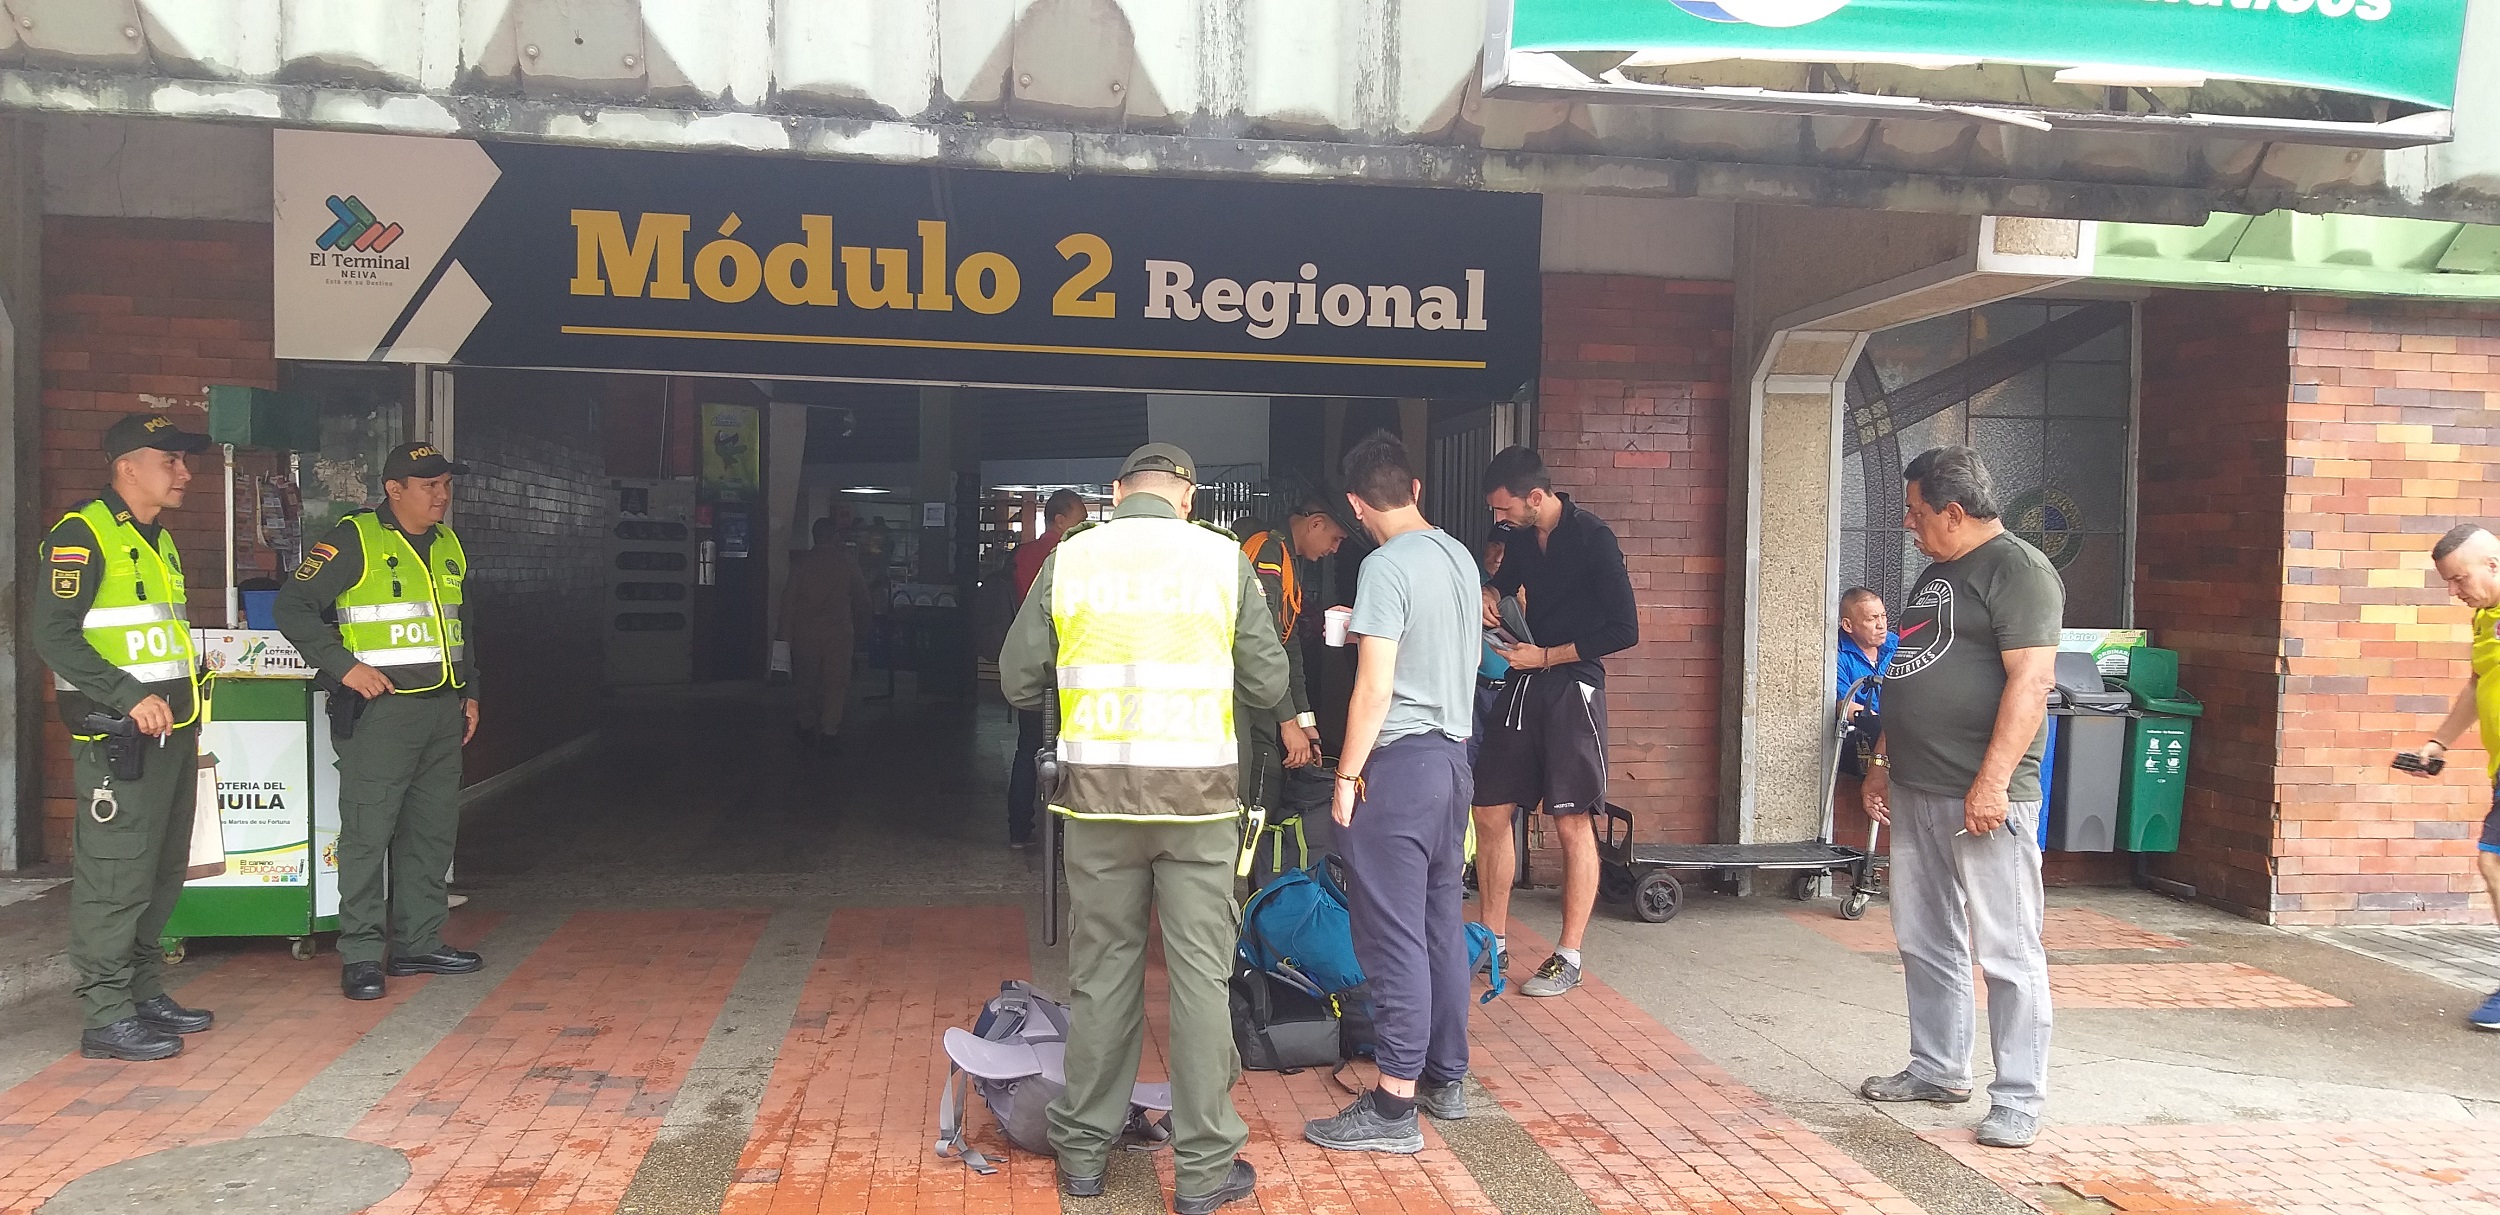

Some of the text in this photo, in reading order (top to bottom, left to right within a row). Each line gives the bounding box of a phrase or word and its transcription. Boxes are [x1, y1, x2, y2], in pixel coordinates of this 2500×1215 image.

[309, 252, 411, 270] El Terminal
[341, 270, 377, 279] NEIVA
[569, 208, 1489, 340] Módulo 2 Regional
[264, 657, 309, 669] HUIL
[216, 782, 286, 790] OTERIA DEL
